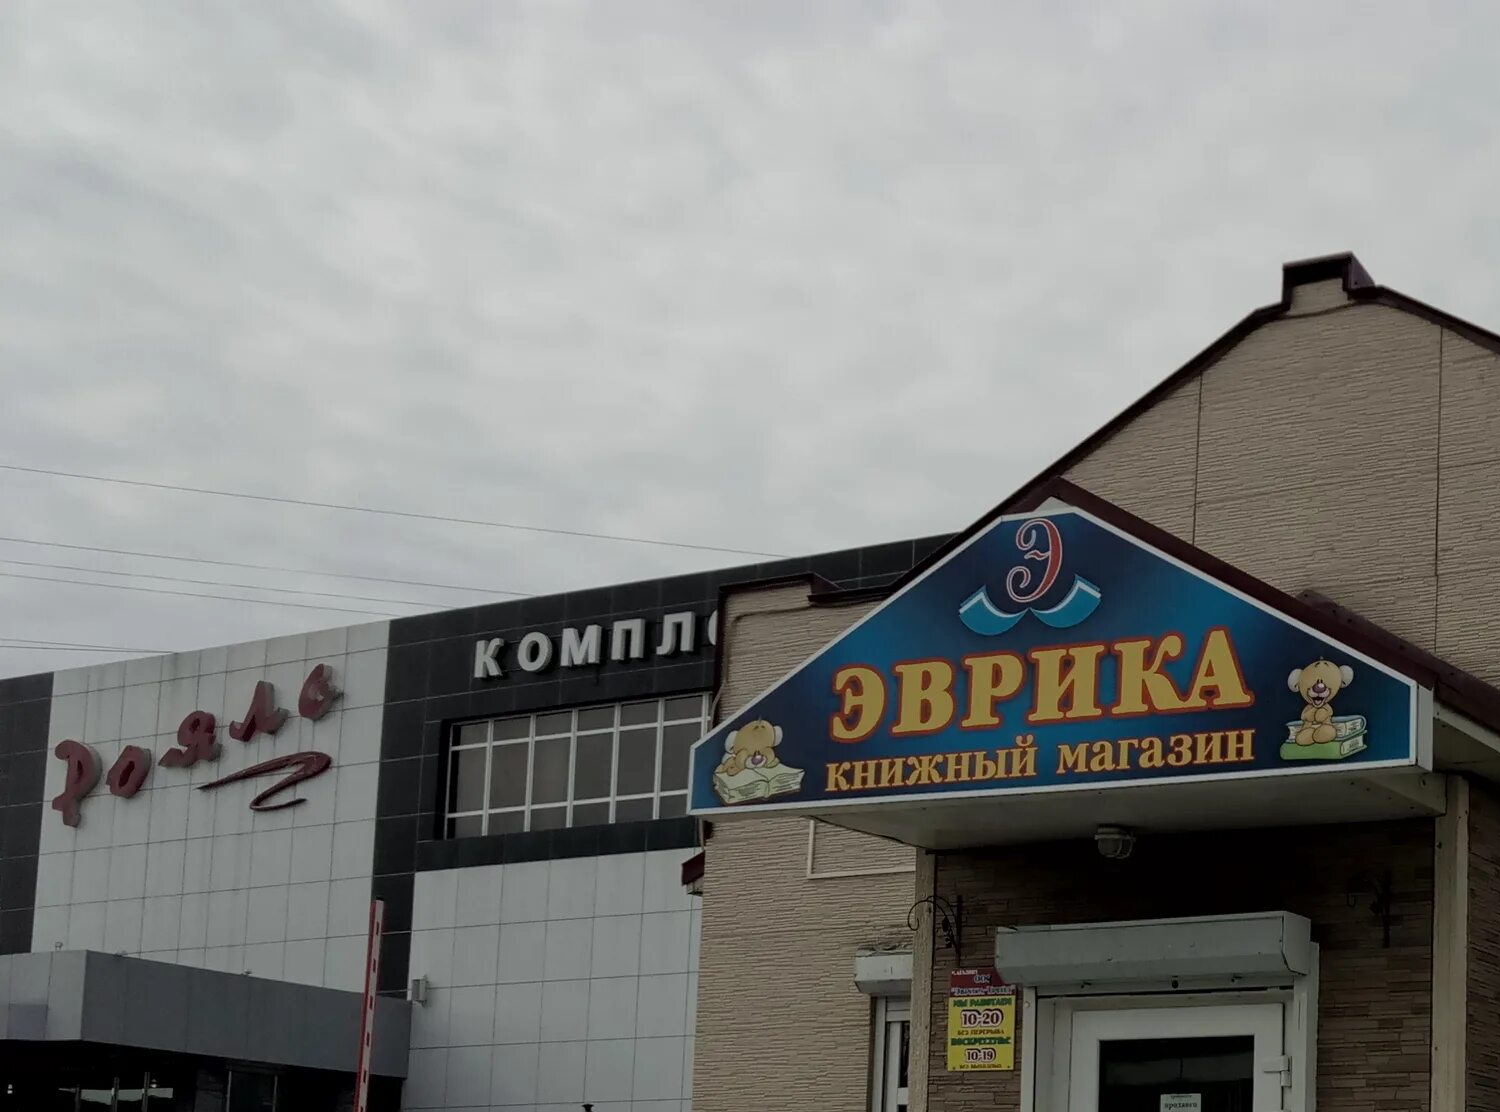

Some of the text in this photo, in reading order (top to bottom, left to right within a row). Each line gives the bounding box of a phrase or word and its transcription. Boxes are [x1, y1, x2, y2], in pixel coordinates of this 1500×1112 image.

[1005, 518, 1063, 603] Э
[830, 627, 1254, 741] ЭВРИКА
[824, 729, 1256, 792] книжный магазин
